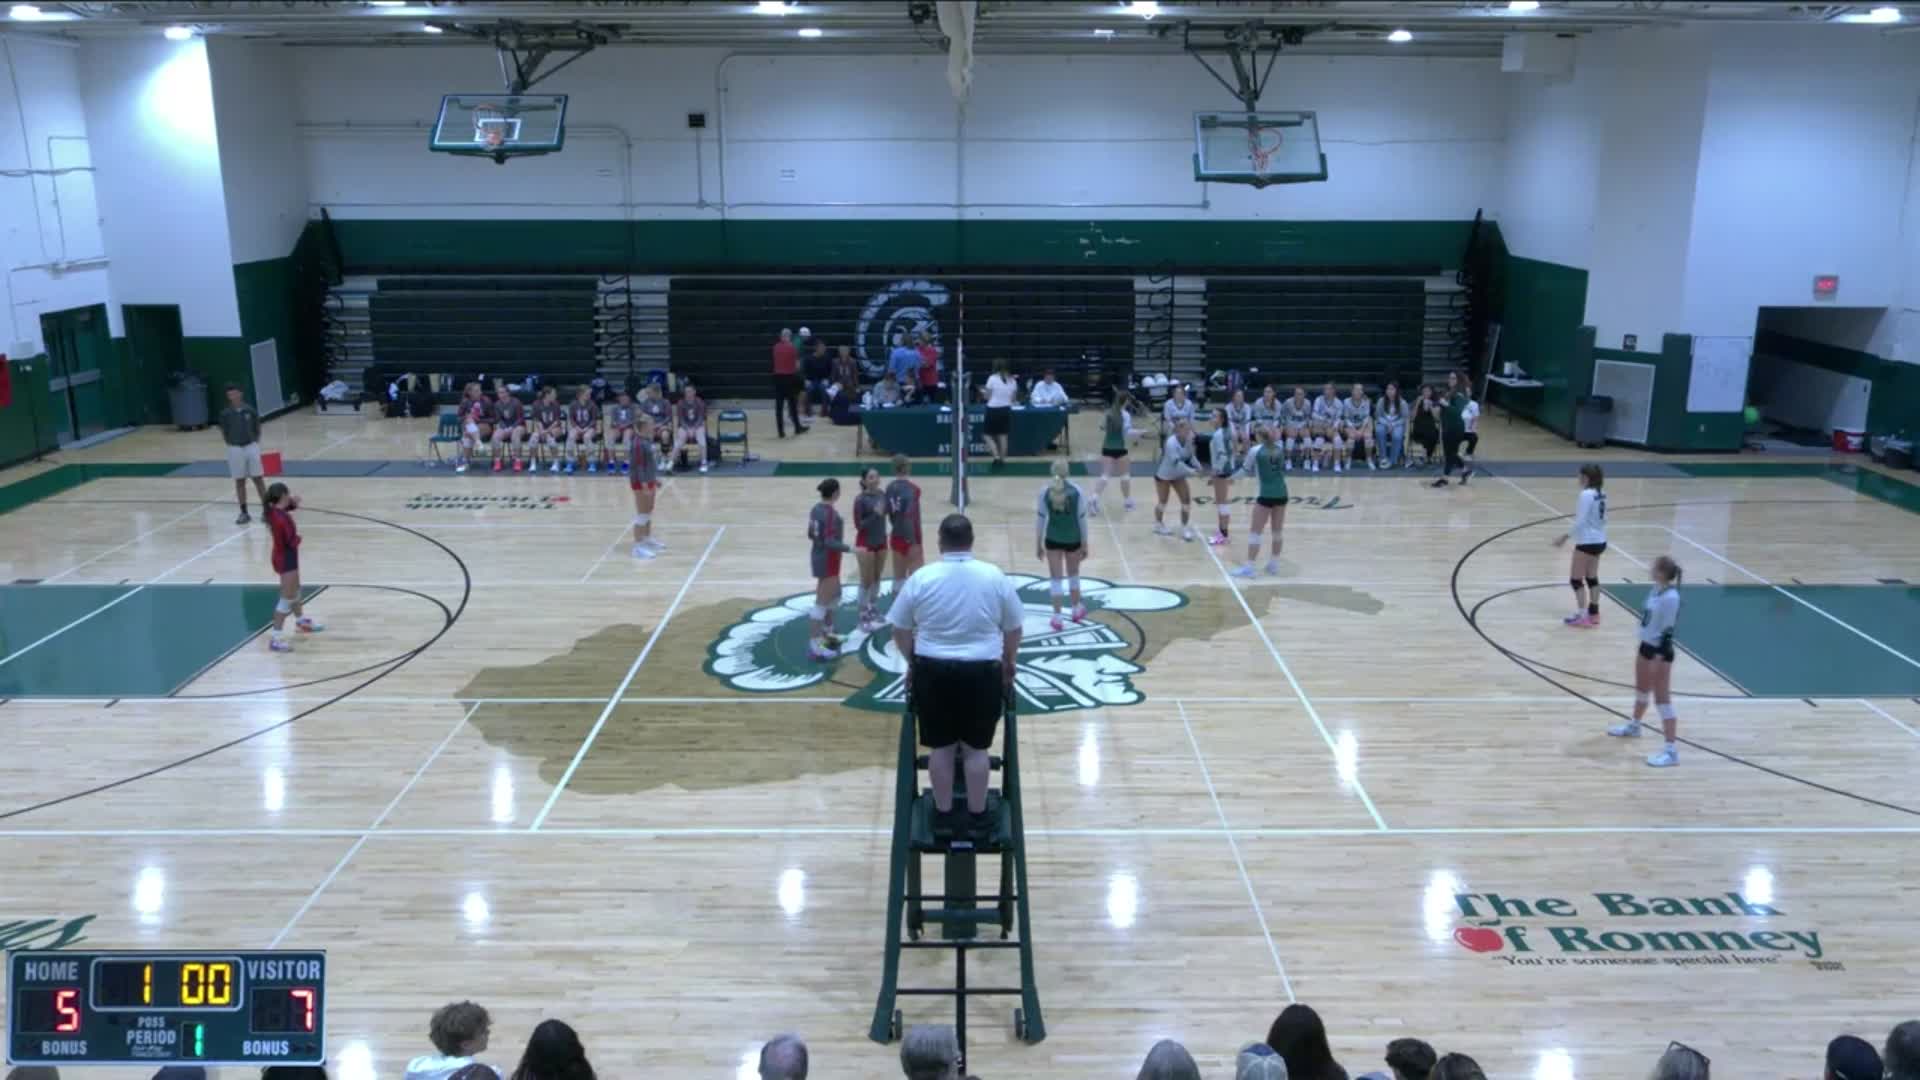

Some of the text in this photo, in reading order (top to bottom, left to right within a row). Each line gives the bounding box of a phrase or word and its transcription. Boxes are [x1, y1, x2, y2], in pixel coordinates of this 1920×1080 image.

[1454, 892, 1787, 925] The Bank
[1549, 926, 1824, 957] Romney
[1574, 956, 1658, 966] someone
[1663, 955, 1729, 969] special
